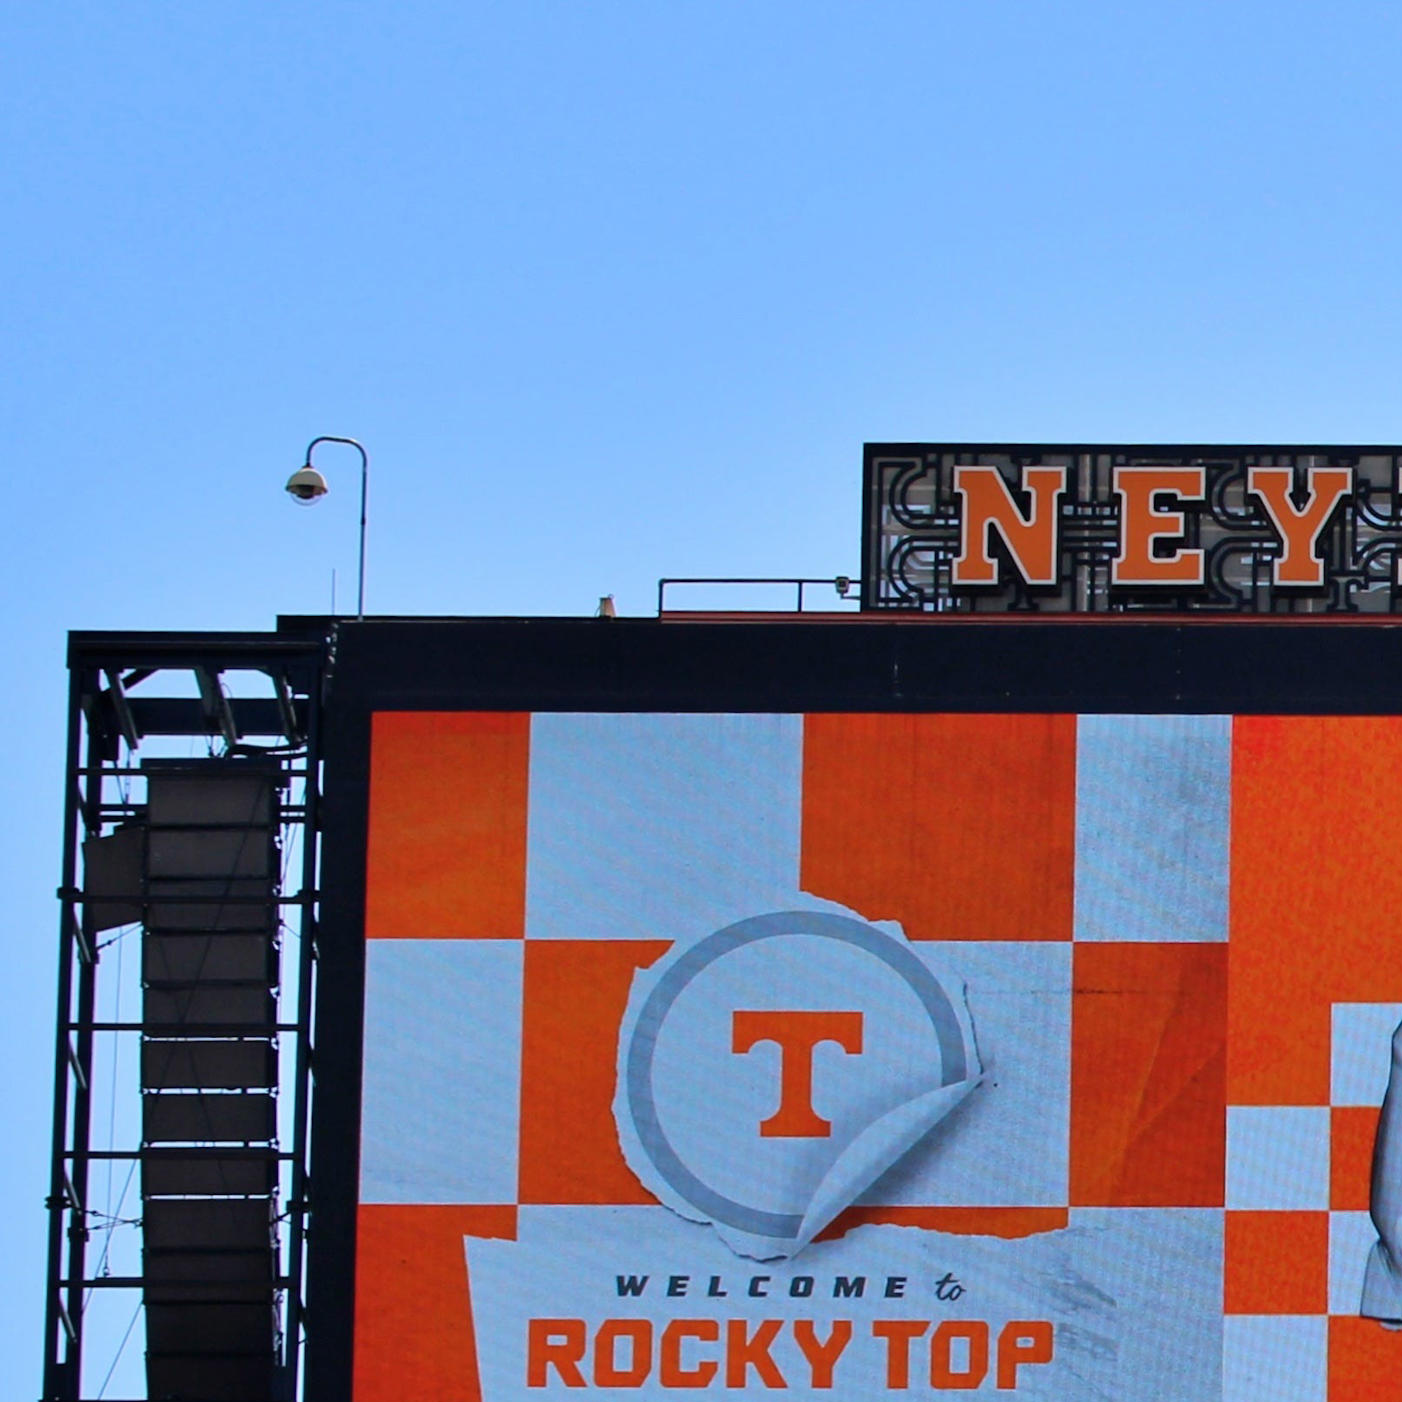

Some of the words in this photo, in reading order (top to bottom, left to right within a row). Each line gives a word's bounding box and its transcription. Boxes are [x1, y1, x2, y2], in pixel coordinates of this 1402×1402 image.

[731, 1010, 863, 1138] T
[614, 1275, 908, 1299] WELCOME
[934, 1271, 967, 1301] to
[526, 1319, 852, 1389] ROCKY
[872, 1320, 1054, 1390] TOP
